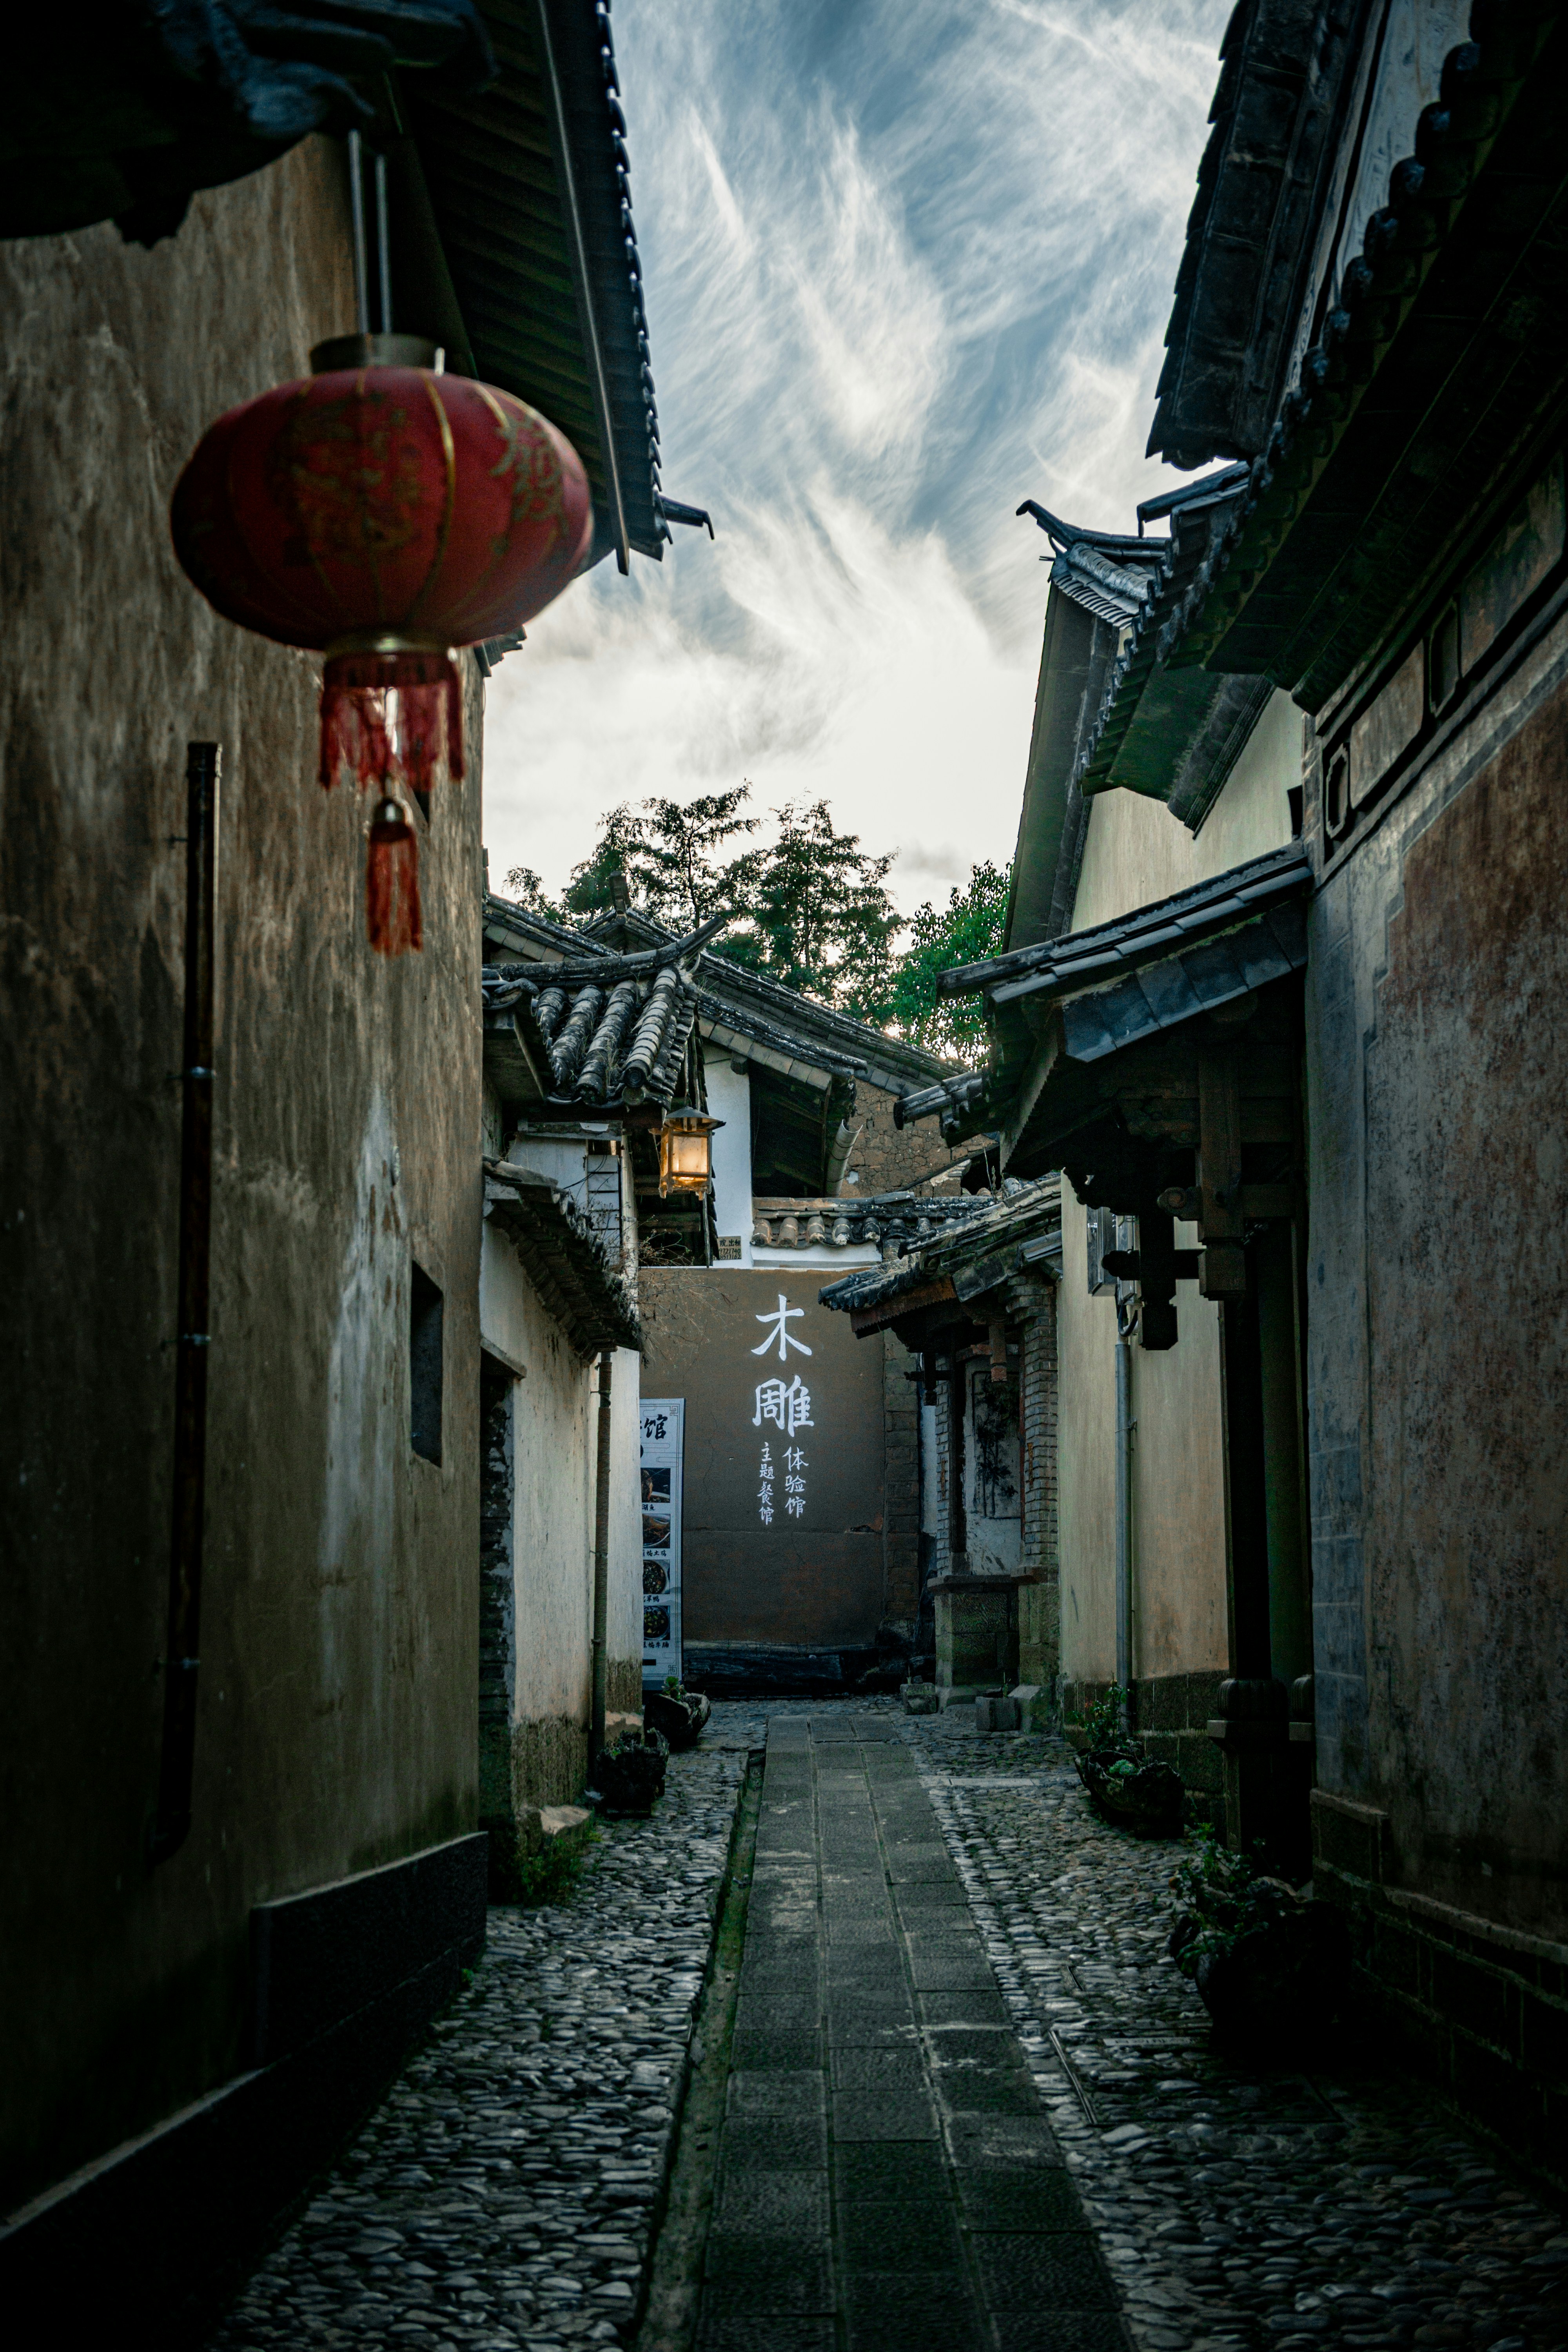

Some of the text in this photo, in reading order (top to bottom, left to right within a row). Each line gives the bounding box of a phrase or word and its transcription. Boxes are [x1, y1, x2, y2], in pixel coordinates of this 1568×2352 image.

[751, 1294, 815, 1437] 木雕
[640, 1414, 668, 1440] 馆
[757, 1442, 775, 1525] 主题餐馆
[782, 1446, 809, 1518] 体验馆
